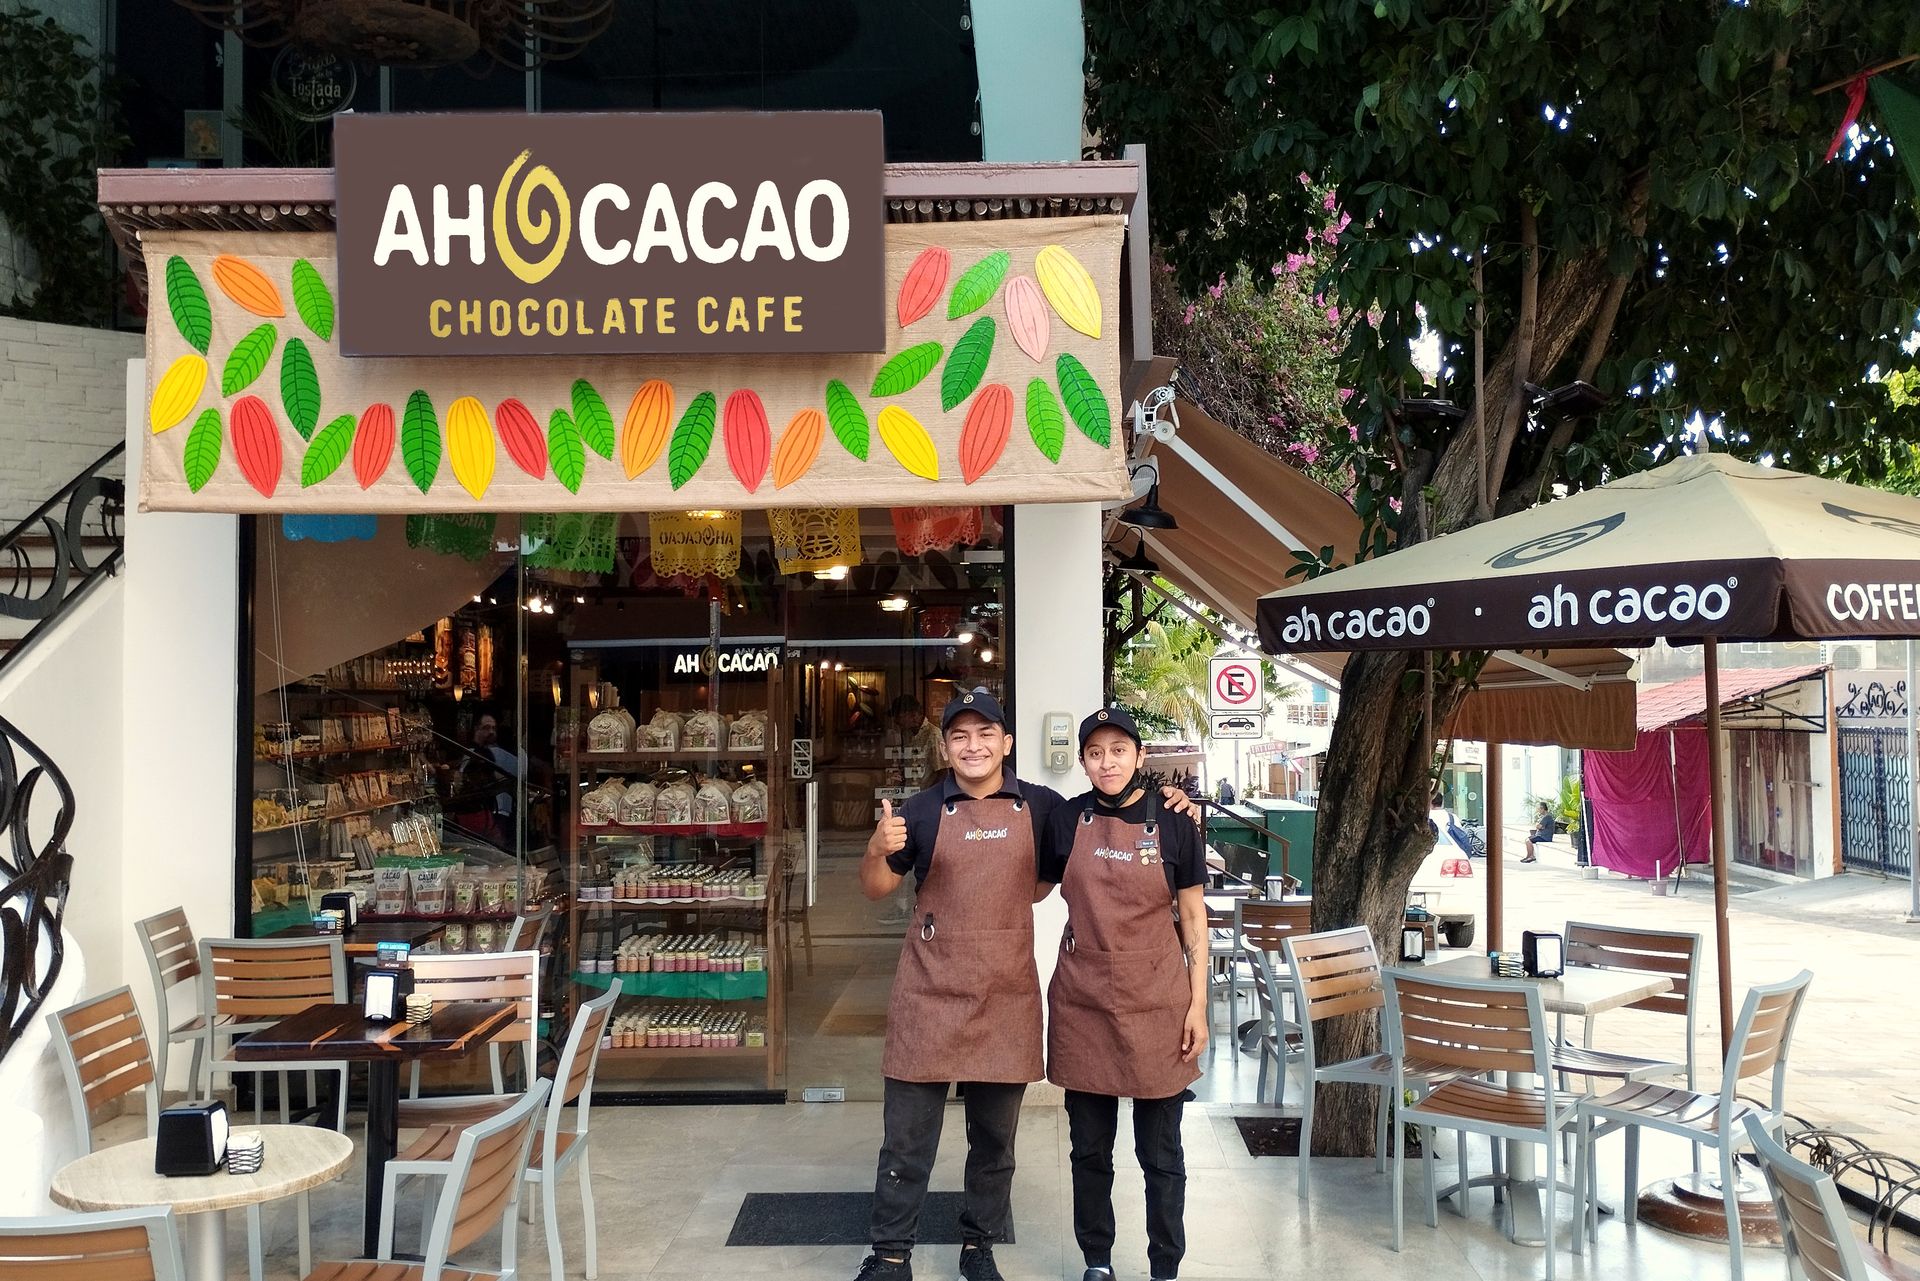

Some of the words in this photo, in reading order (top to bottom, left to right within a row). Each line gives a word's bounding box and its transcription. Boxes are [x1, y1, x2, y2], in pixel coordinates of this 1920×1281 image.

[288, 76, 341, 109] Tostada
[373, 183, 486, 266] AH
[579, 179, 850, 265] CACAO
[430, 298, 676, 337] CHOCOLATE
[698, 296, 804, 334] CAFE
[1528, 584, 1578, 628] ah
[1282, 605, 1322, 643] ah
[673, 653, 700, 673] AH
[718, 652, 778, 673] CACAO
[965, 829, 976, 840] AH
[1094, 847, 1105, 857] AH
[382, 871, 401, 880] CACAO
[418, 872, 438, 881] CACAO
